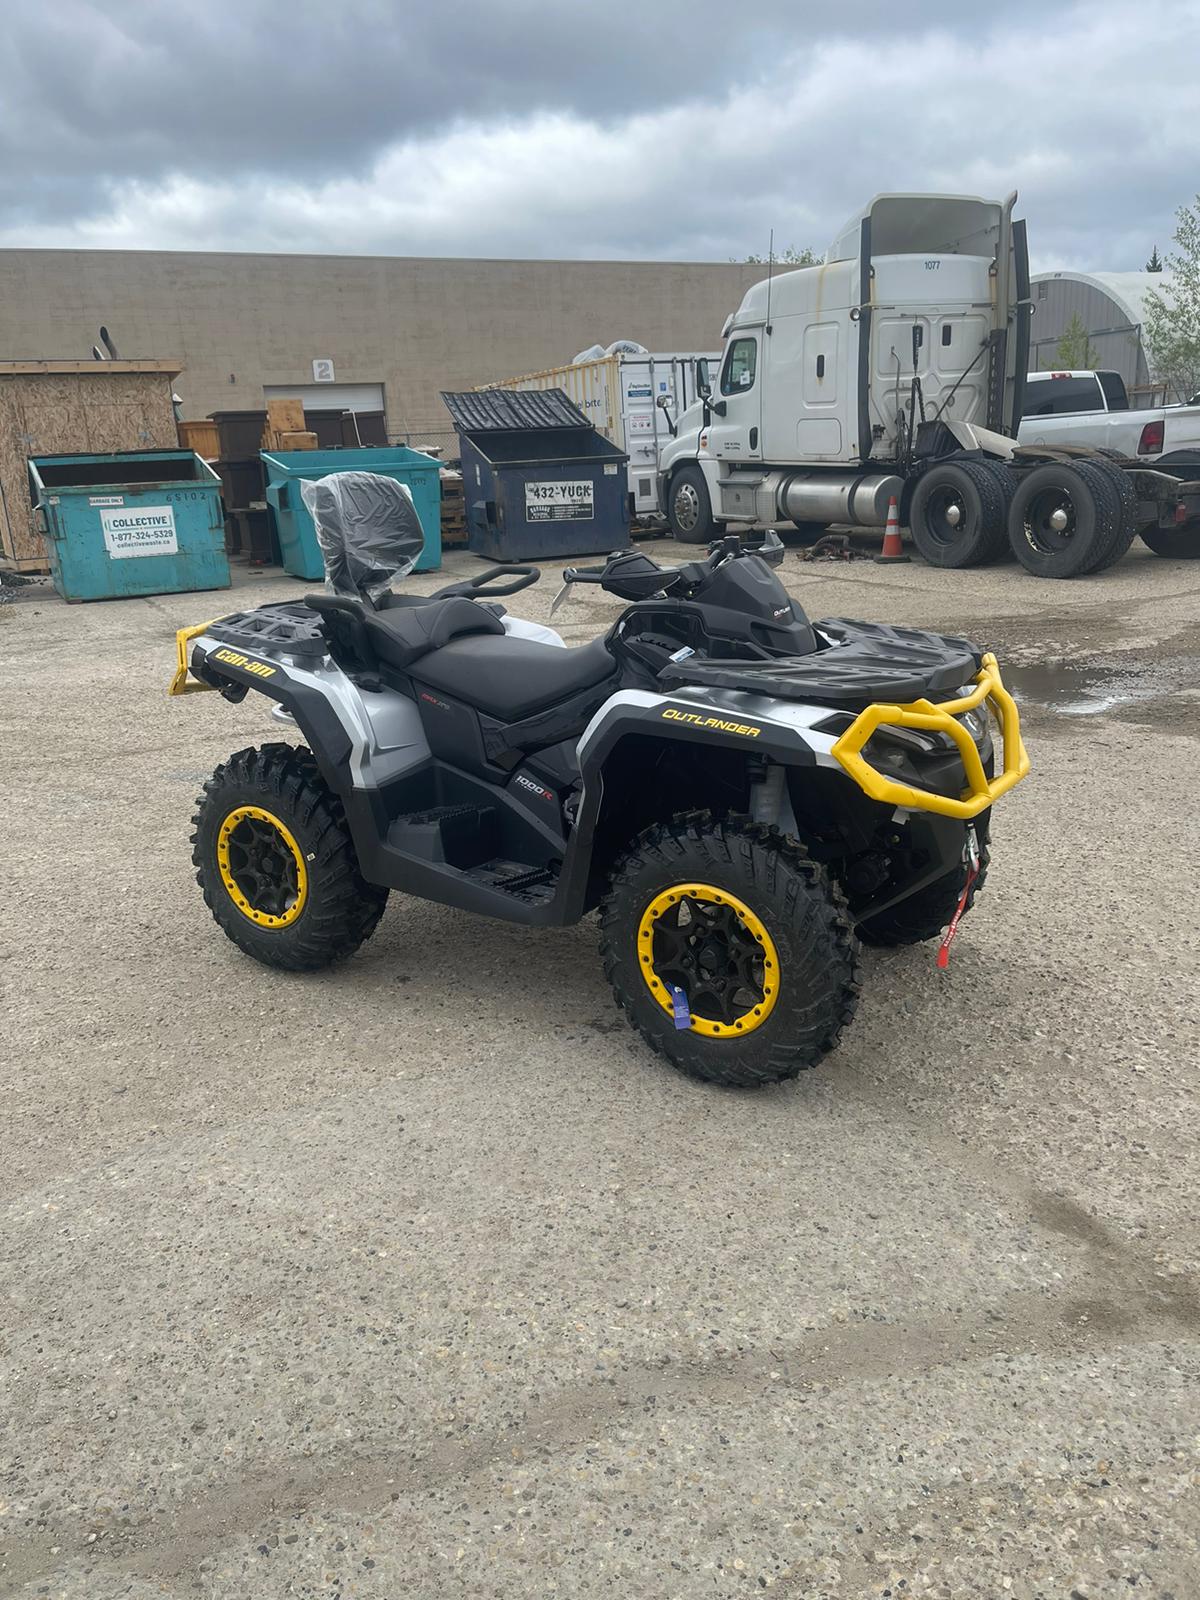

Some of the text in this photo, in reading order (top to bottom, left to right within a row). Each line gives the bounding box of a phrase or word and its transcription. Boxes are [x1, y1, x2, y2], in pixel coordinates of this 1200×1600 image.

[924, 261, 941, 270] 1077
[317, 362, 331, 380] 2
[534, 485, 592, 499] 432-YUCK
[113, 516, 168, 528] COLLECTIVE
[111, 530, 174, 542] 1-877-324-5329
[117, 540, 171, 549] collectivewaste.ca
[662, 709, 761, 738] OUTLANDER
[516, 775, 554, 801] 1000R
